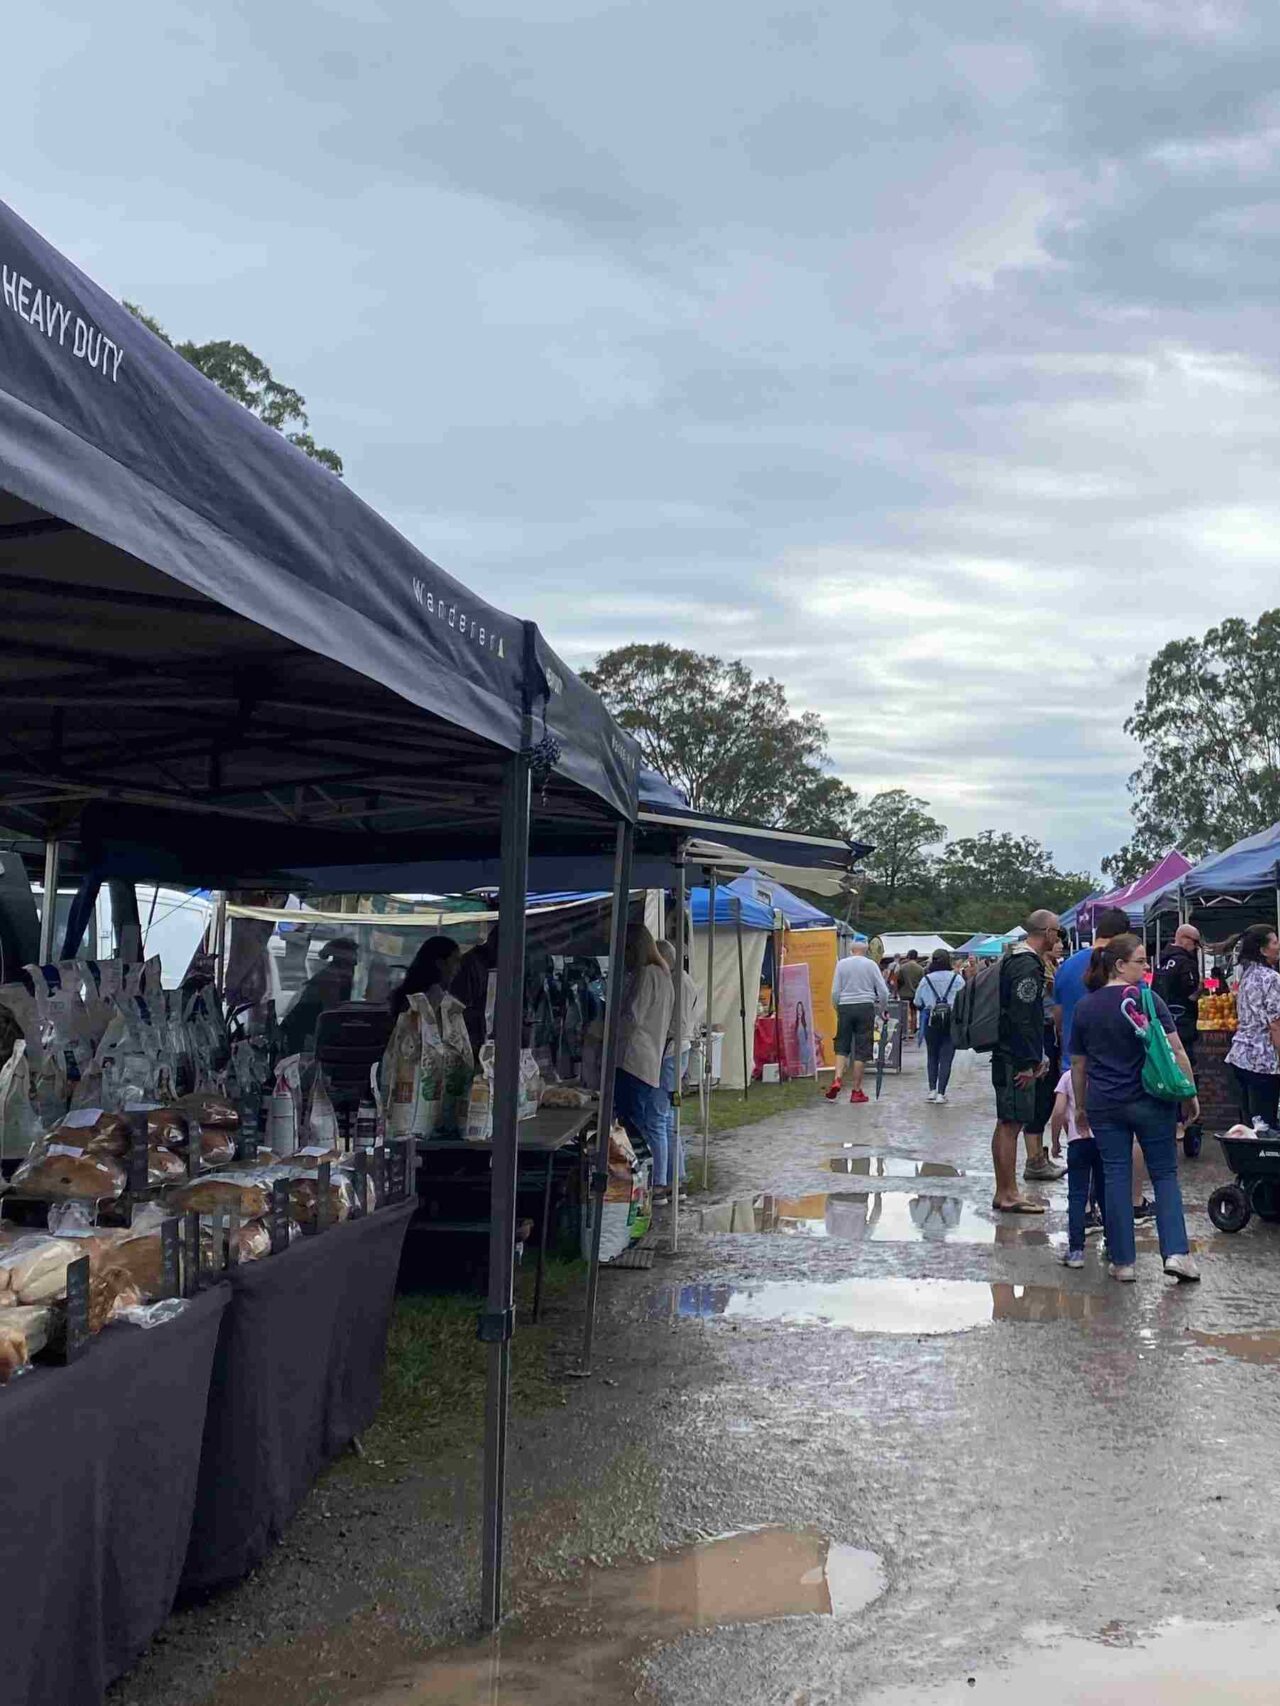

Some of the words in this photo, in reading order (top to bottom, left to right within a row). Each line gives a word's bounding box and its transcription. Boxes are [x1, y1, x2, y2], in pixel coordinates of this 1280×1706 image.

[3, 264, 71, 346] HEAVY
[73, 317, 123, 382] DUTY
[412, 577, 496, 651] Wanderer
